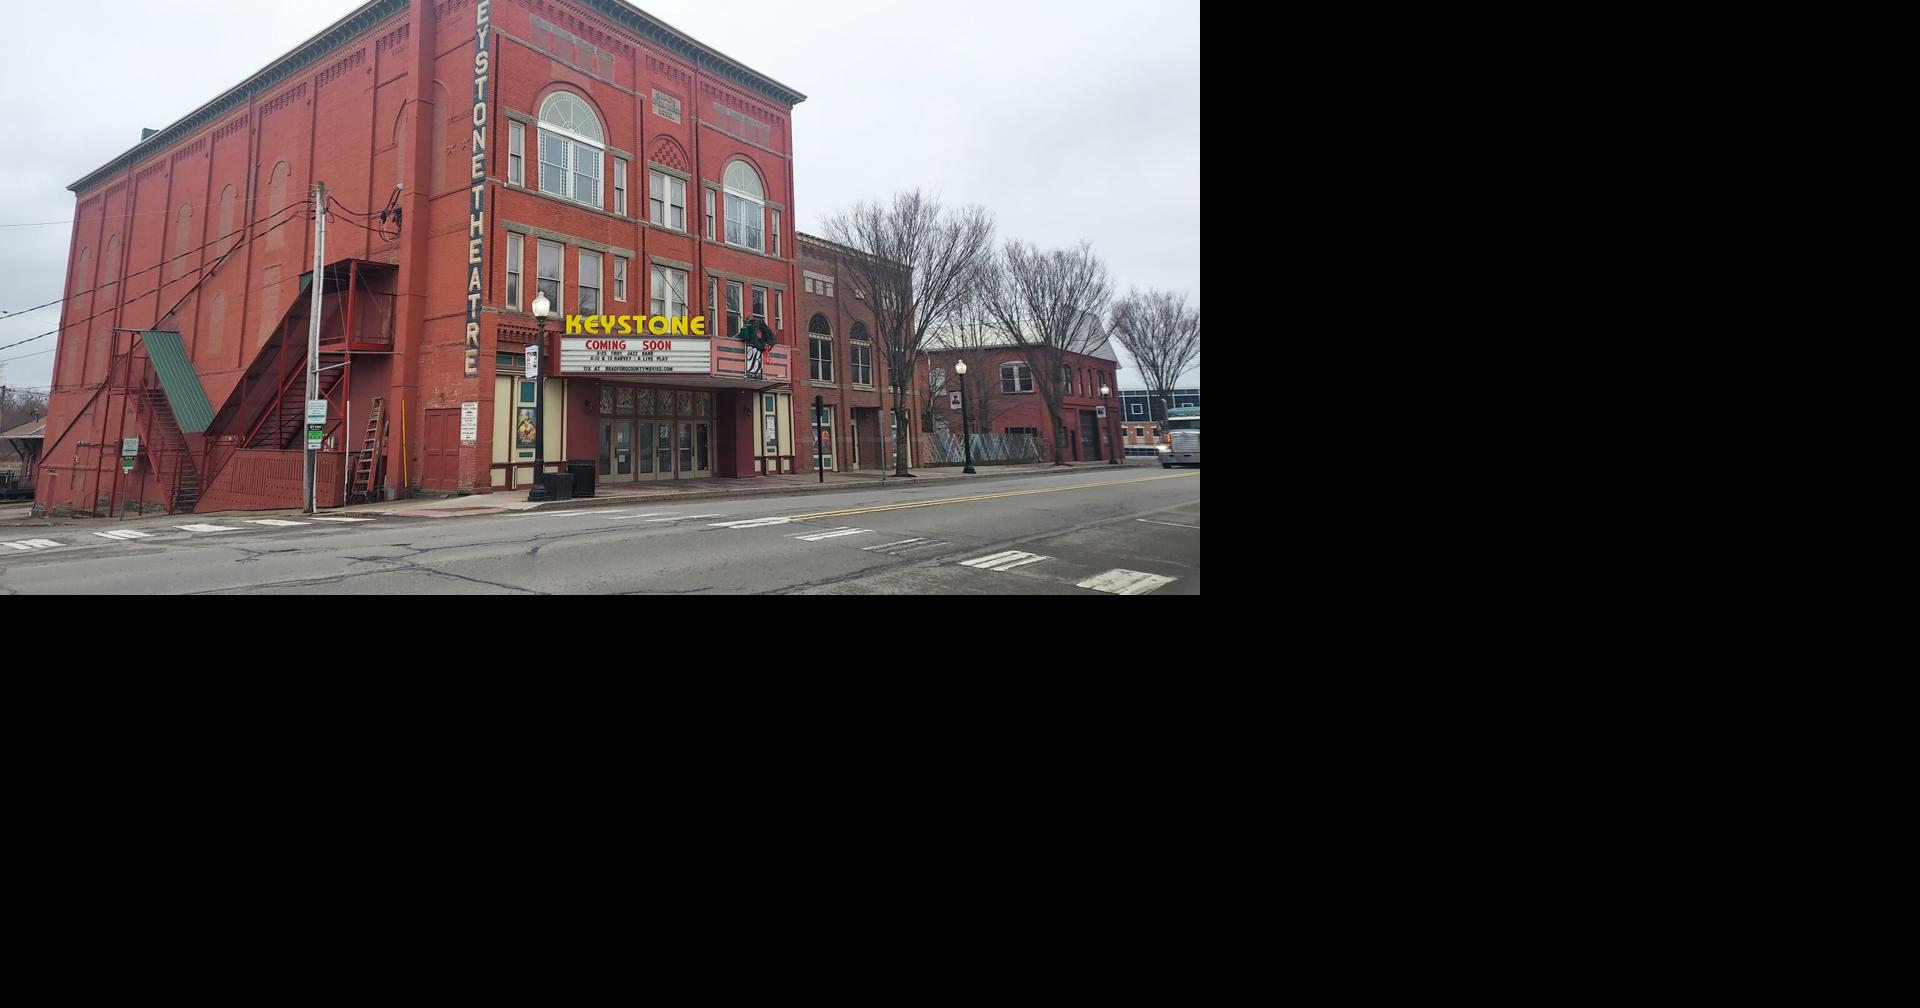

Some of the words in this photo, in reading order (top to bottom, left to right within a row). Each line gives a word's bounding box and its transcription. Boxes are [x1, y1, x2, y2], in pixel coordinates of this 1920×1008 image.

[464, 184, 484, 376] THEATRE
[565, 314, 705, 335] KEYSTONE
[585, 340, 627, 350] COMING
[642, 340, 672, 350] SOON
